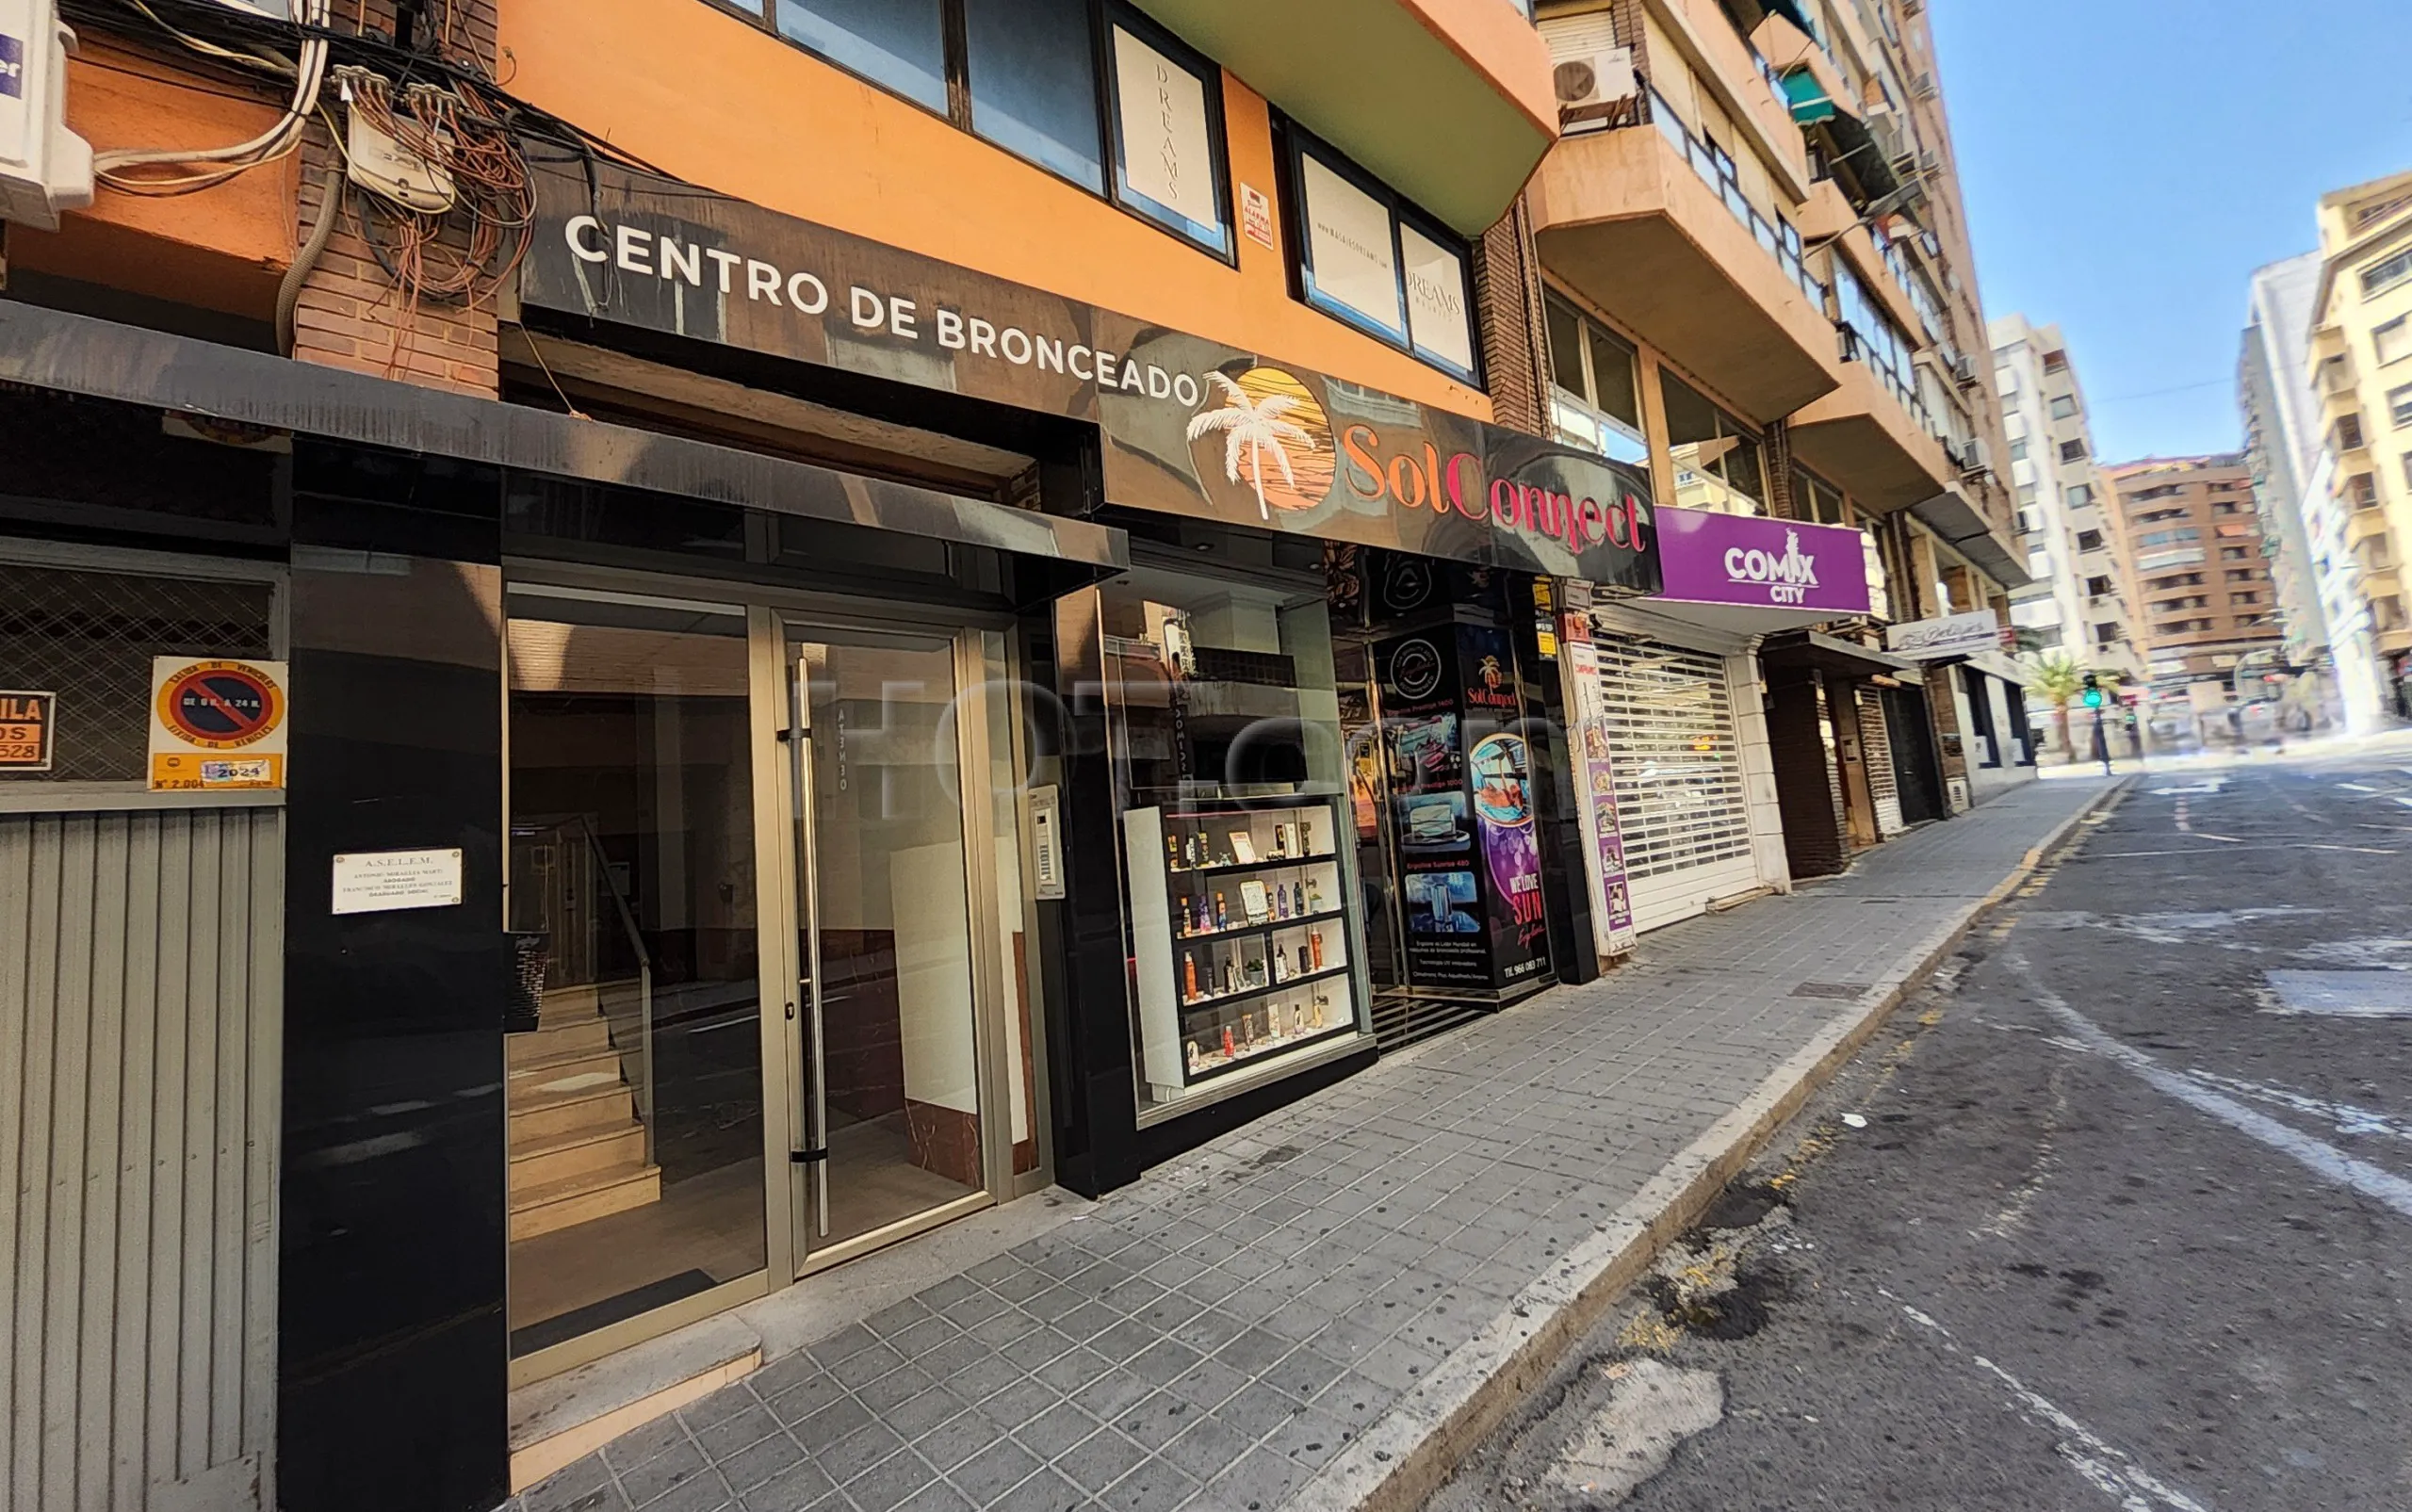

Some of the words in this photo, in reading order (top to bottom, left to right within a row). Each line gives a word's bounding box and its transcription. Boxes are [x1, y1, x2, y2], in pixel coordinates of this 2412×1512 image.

[1157, 63, 1178, 200] DREAMS
[565, 215, 829, 316] CENTRO
[851, 286, 919, 339] DE
[936, 309, 1199, 408] BRONCEADO
[1342, 424, 1646, 554] SolConnect
[1724, 533, 1819, 586] COMIX
[1769, 586, 1805, 604] CITY
[183, 697, 196, 707] DE
[224, 697, 232, 707] A
[235, 697, 249, 707] 24
[1467, 688, 1517, 707] SolConnect
[206, 740, 220, 749] DE
[218, 767, 261, 778] 2024
[1509, 877, 1523, 894] WE
[1521, 873, 1540, 892] LOVE
[1512, 890, 1542, 925] SUN
[1514, 963, 1525, 976] 966
[1536, 955, 1547, 967] 711
